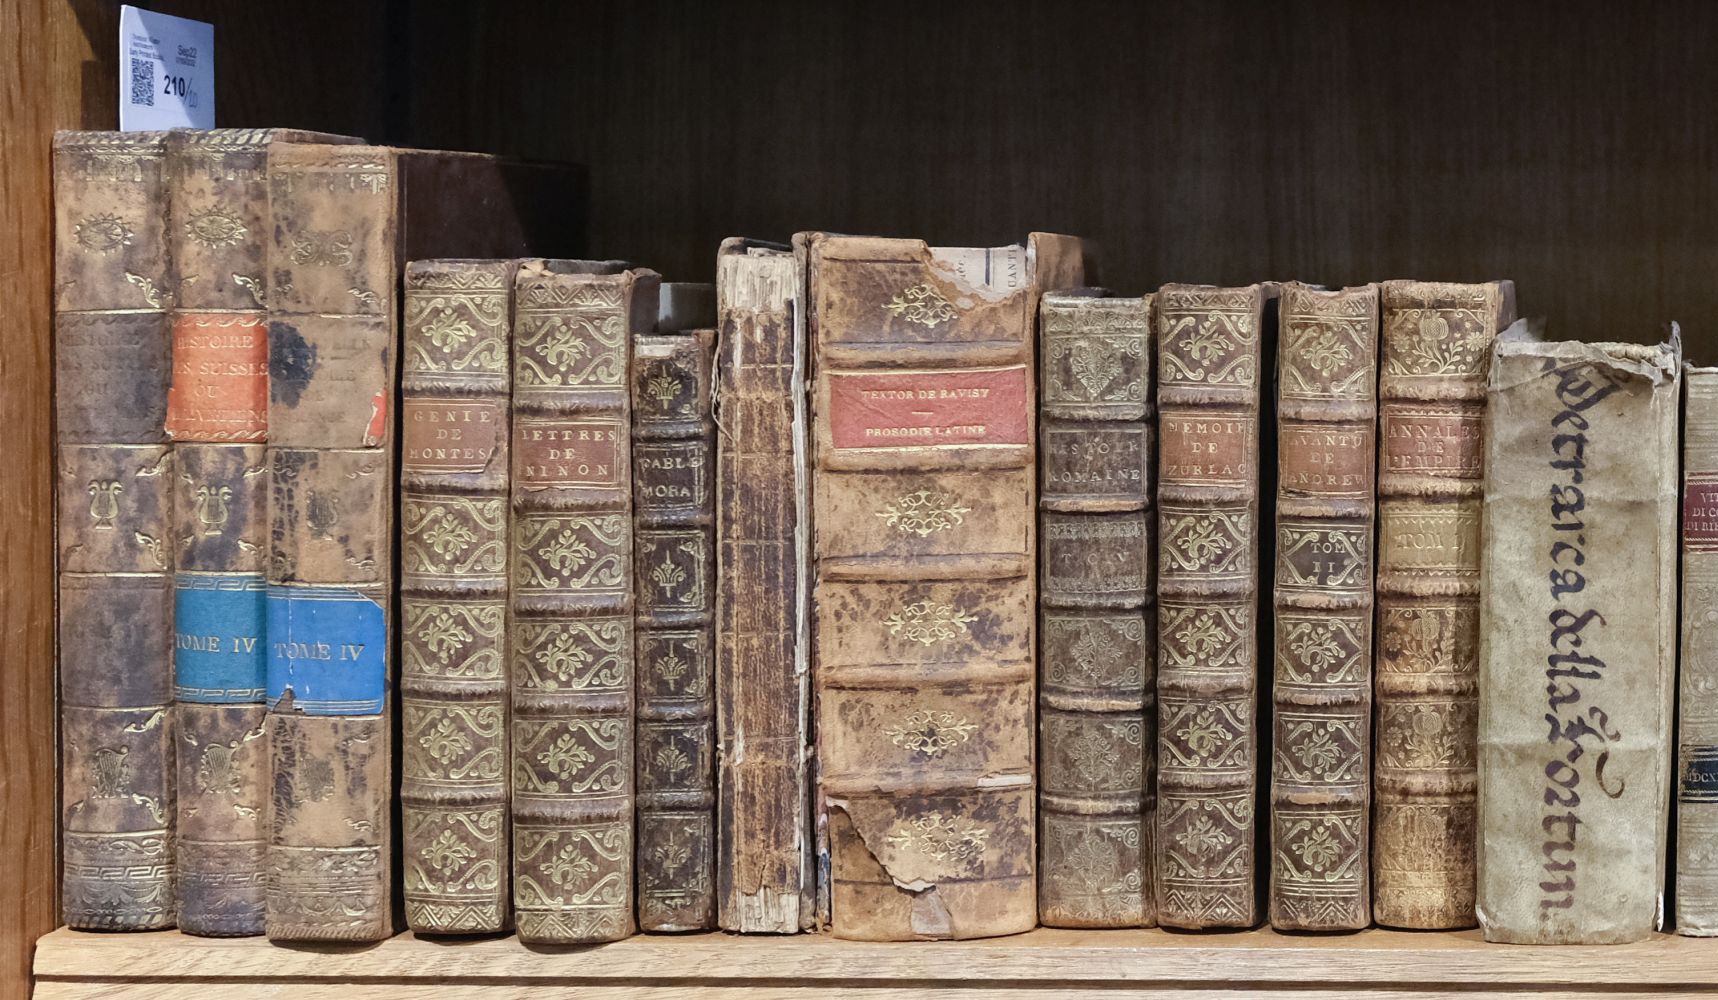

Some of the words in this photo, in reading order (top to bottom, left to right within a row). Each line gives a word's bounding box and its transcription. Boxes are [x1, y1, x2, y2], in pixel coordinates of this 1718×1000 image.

[862, 390, 914, 399] TEXTOR
[918, 390, 936, 399] DE
[414, 411, 490, 422] GENIE
[436, 429, 462, 440] DE
[522, 430, 616, 441] LETTRES
[866, 427, 932, 437] PROSODIE
[1389, 424, 1480, 439] ANNALES
[1192, 442, 1218, 454] DE
[1417, 441, 1444, 453] DE
[548, 448, 576, 460] DE
[1310, 452, 1334, 463] DE
[526, 464, 608, 477] NINON
[1692, 507, 1706, 517] DI
[1310, 542, 1346, 553] TOM
[175, 633, 221, 653] TOME
[233, 637, 257, 654] IV
[274, 642, 331, 660] TOME
[340, 645, 365, 661] IV
[1545, 608, 1607, 716] della
